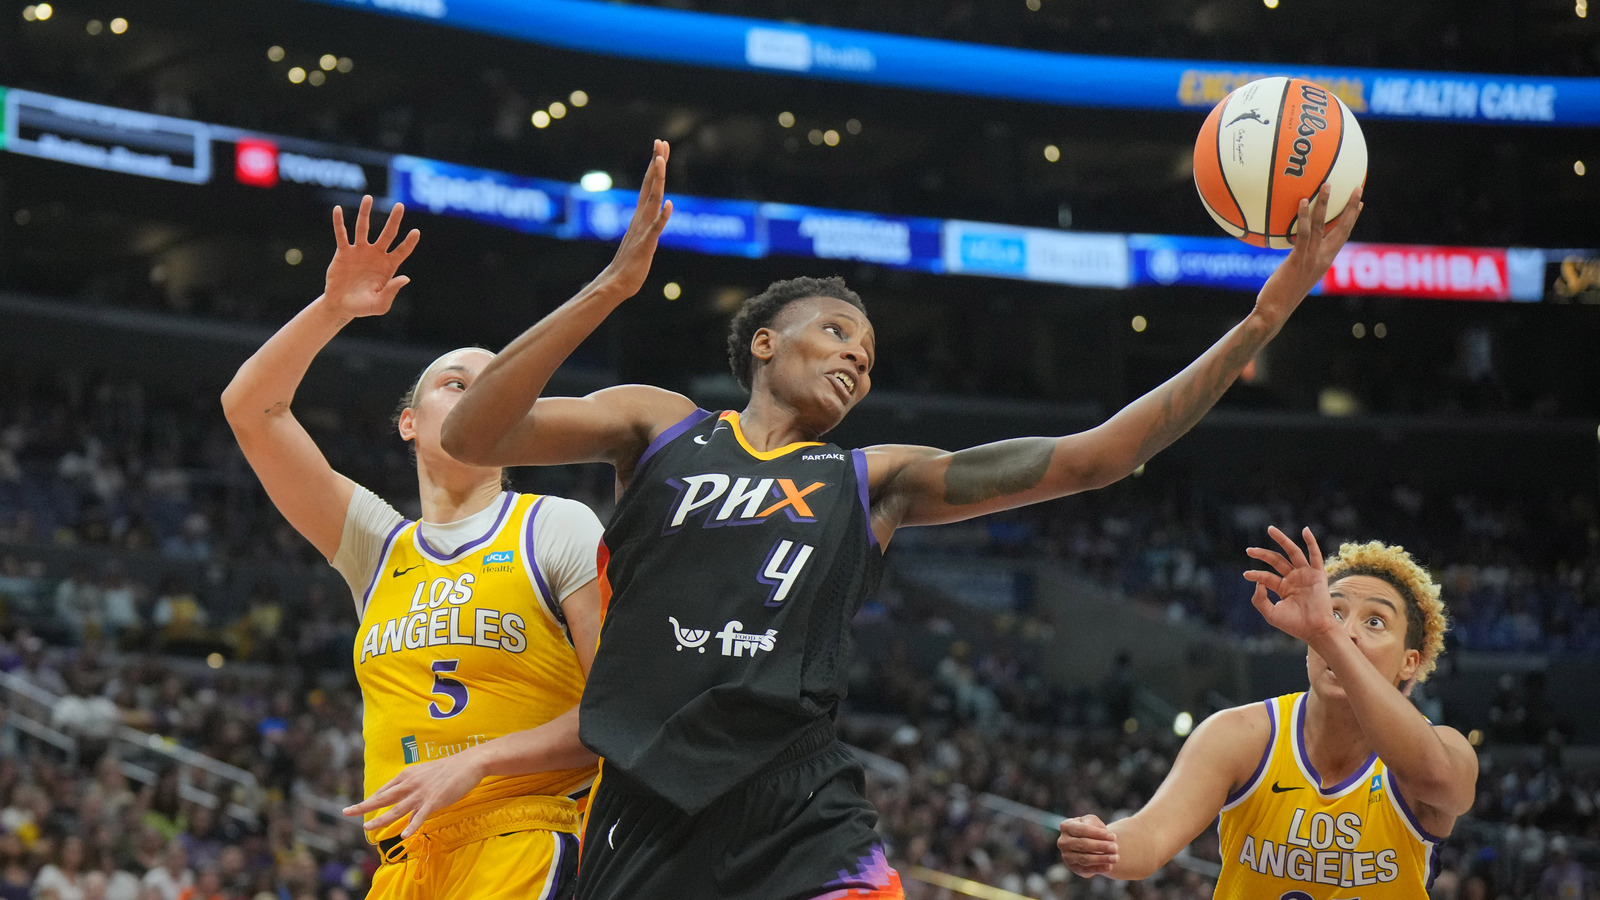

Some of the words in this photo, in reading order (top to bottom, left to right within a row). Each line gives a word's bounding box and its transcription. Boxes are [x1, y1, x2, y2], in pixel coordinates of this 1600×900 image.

[1371, 78, 1479, 118] HEALTH
[1480, 83, 1556, 121] CARE
[1284, 85, 1328, 177] Wilson
[278, 152, 368, 190] TOYOTA
[411, 168, 551, 222] Spectrum
[1332, 251, 1506, 293] TOSHIBA
[802, 453, 845, 461] PARTAKE
[670, 473, 827, 528] PHX
[482, 565, 513, 573] Health
[486, 553, 510, 562] UCLA
[763, 540, 814, 603] 4
[408, 572, 475, 613] LOS
[360, 606, 527, 664] ANGELES
[428, 659, 469, 719] 5
[424, 734, 489, 759] EquiT
[1286, 808, 1362, 851] LOS
[1239, 834, 1399, 888] ANGELES
